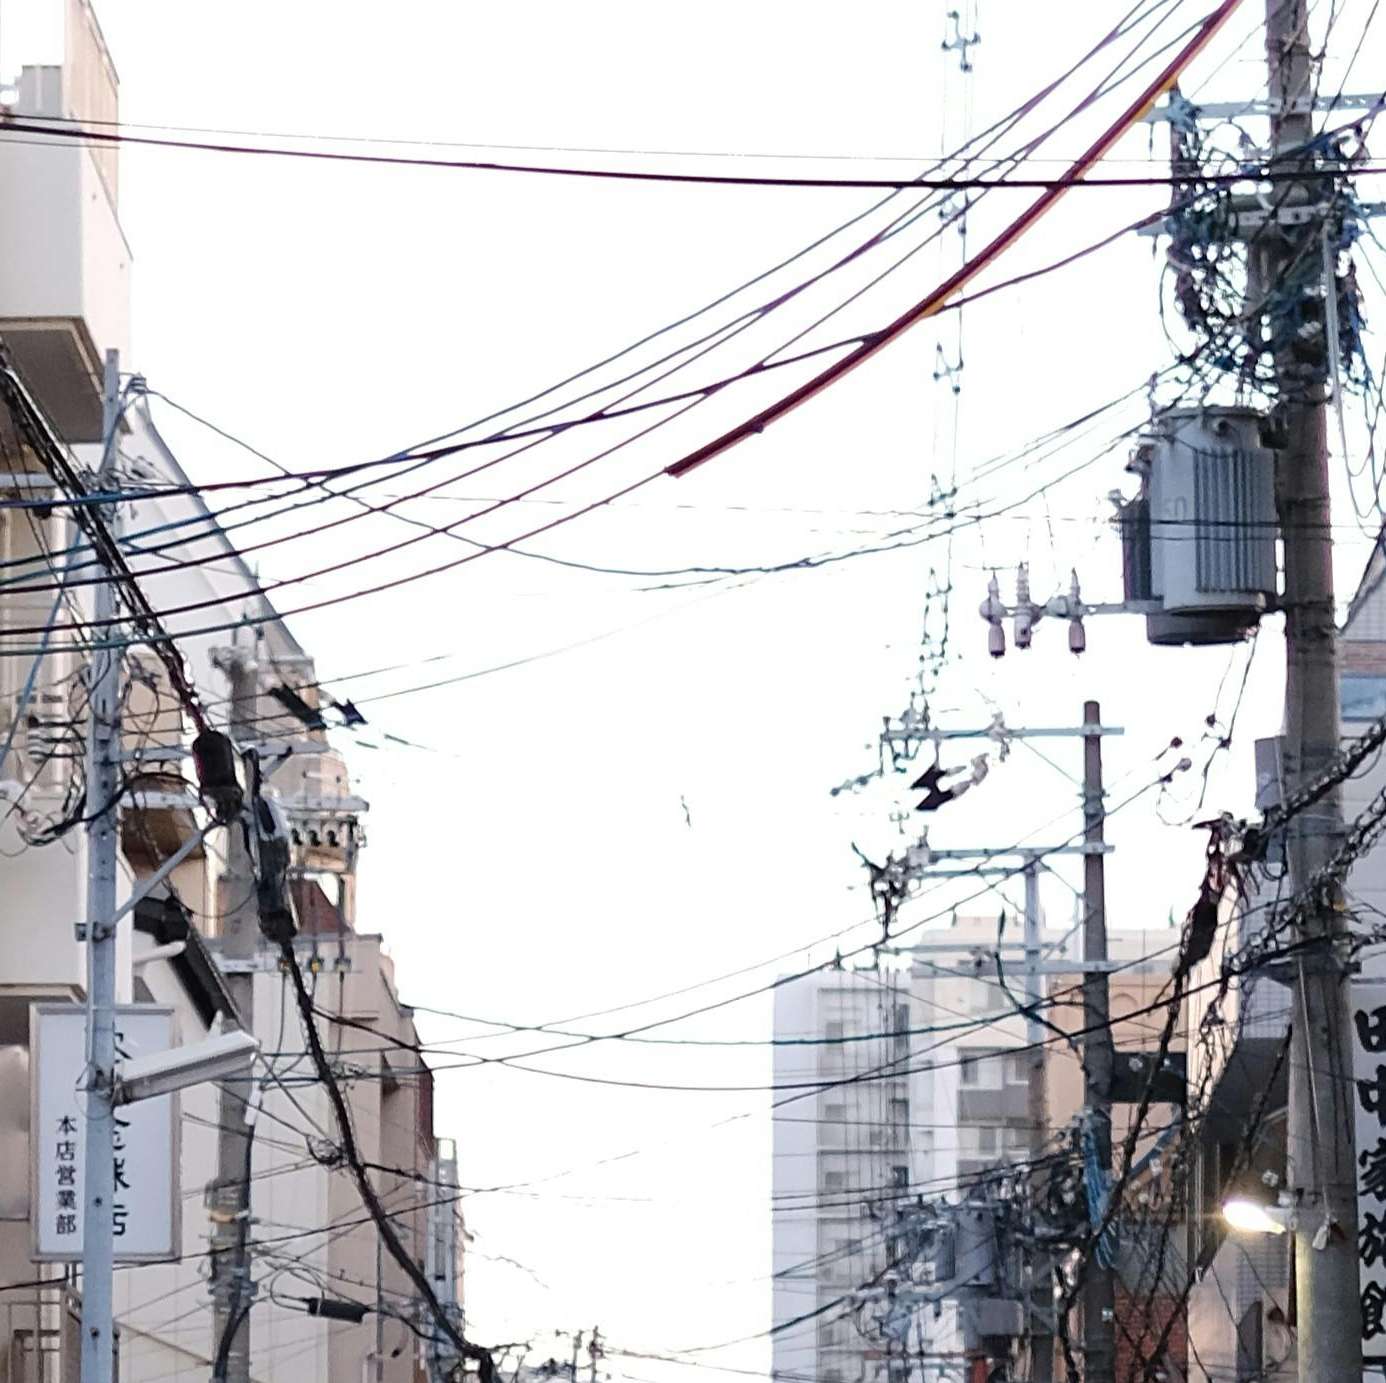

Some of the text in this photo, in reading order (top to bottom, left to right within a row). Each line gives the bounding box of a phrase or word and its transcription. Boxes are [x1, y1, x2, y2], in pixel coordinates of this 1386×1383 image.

[55, 1115, 77, 1235] 本店営業部
